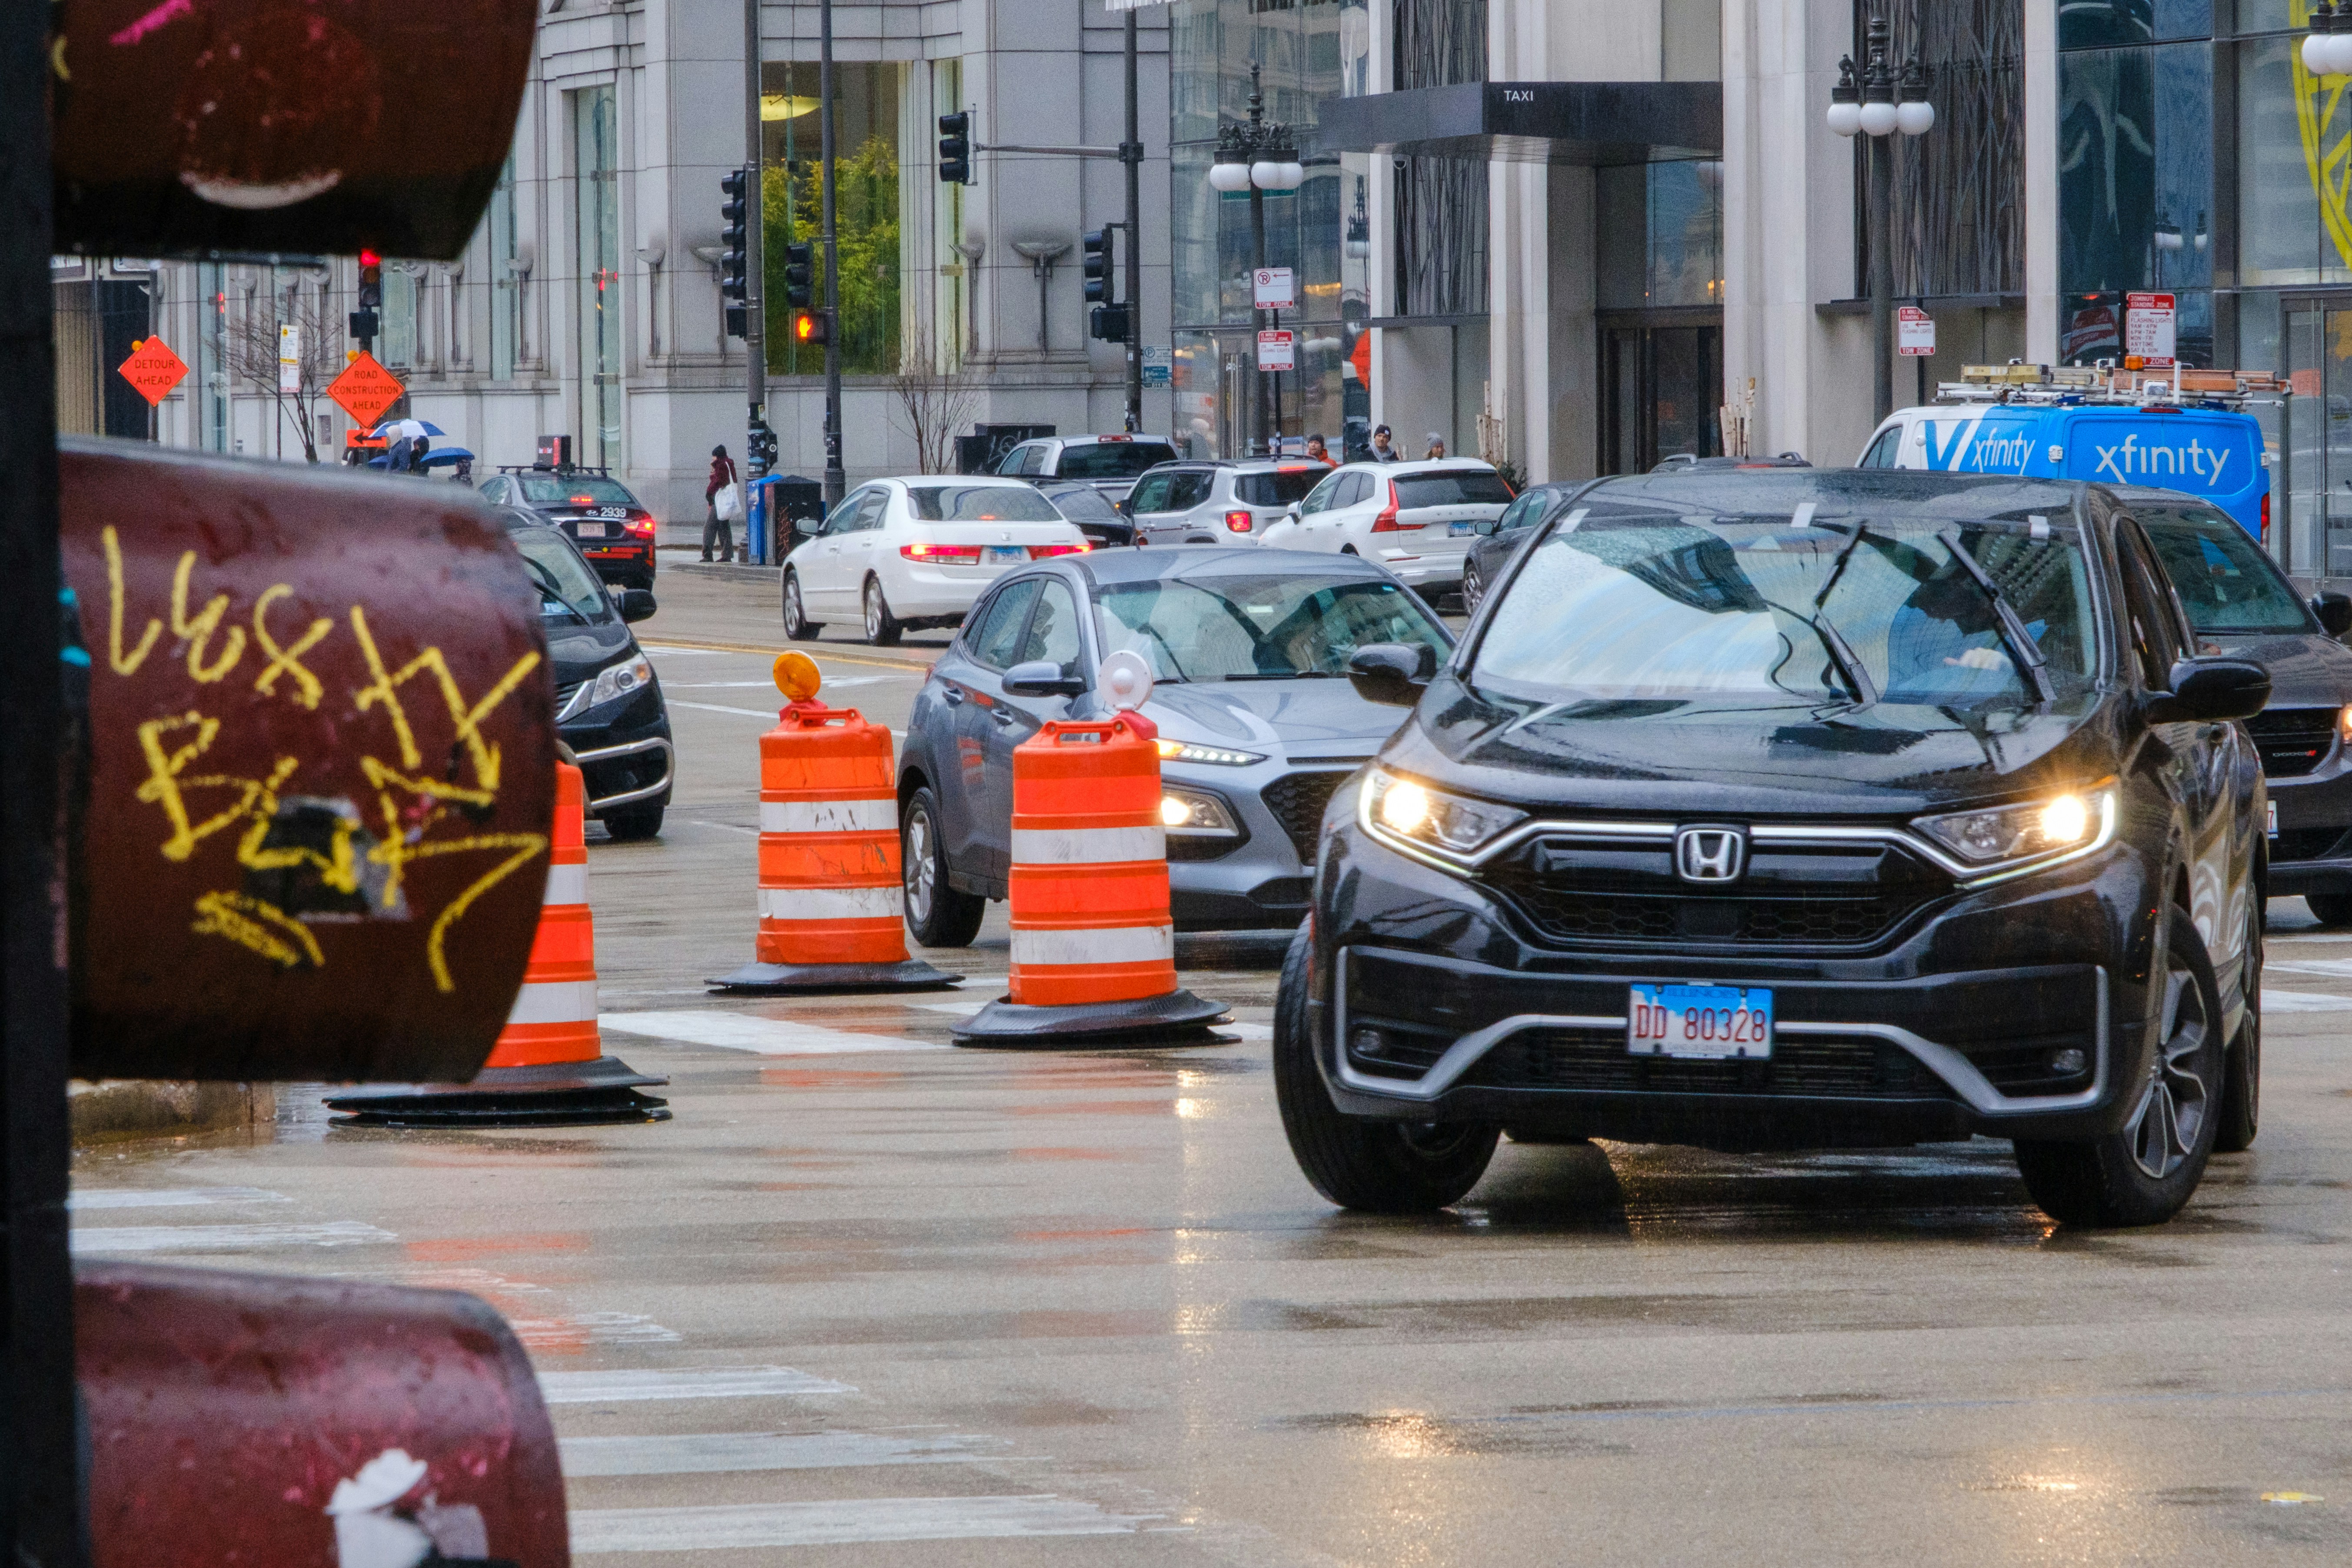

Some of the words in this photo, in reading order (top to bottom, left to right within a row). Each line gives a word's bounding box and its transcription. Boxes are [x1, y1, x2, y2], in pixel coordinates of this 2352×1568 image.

[1504, 90, 1533, 101] TAXI
[135, 360, 175, 369] DETOUR
[355, 371, 377, 379] ROAD
[136, 376, 171, 385] AHEAD
[334, 386, 398, 394] CONSTRUCTION
[352, 401, 381, 409] AHEAD
[1972, 427, 2036, 475] xfinity
[2095, 434, 2230, 486] xfinity
[601, 507, 626, 518] 2939
[1636, 1005, 1667, 1039] DD
[1684, 1007, 1766, 1042] 80328
